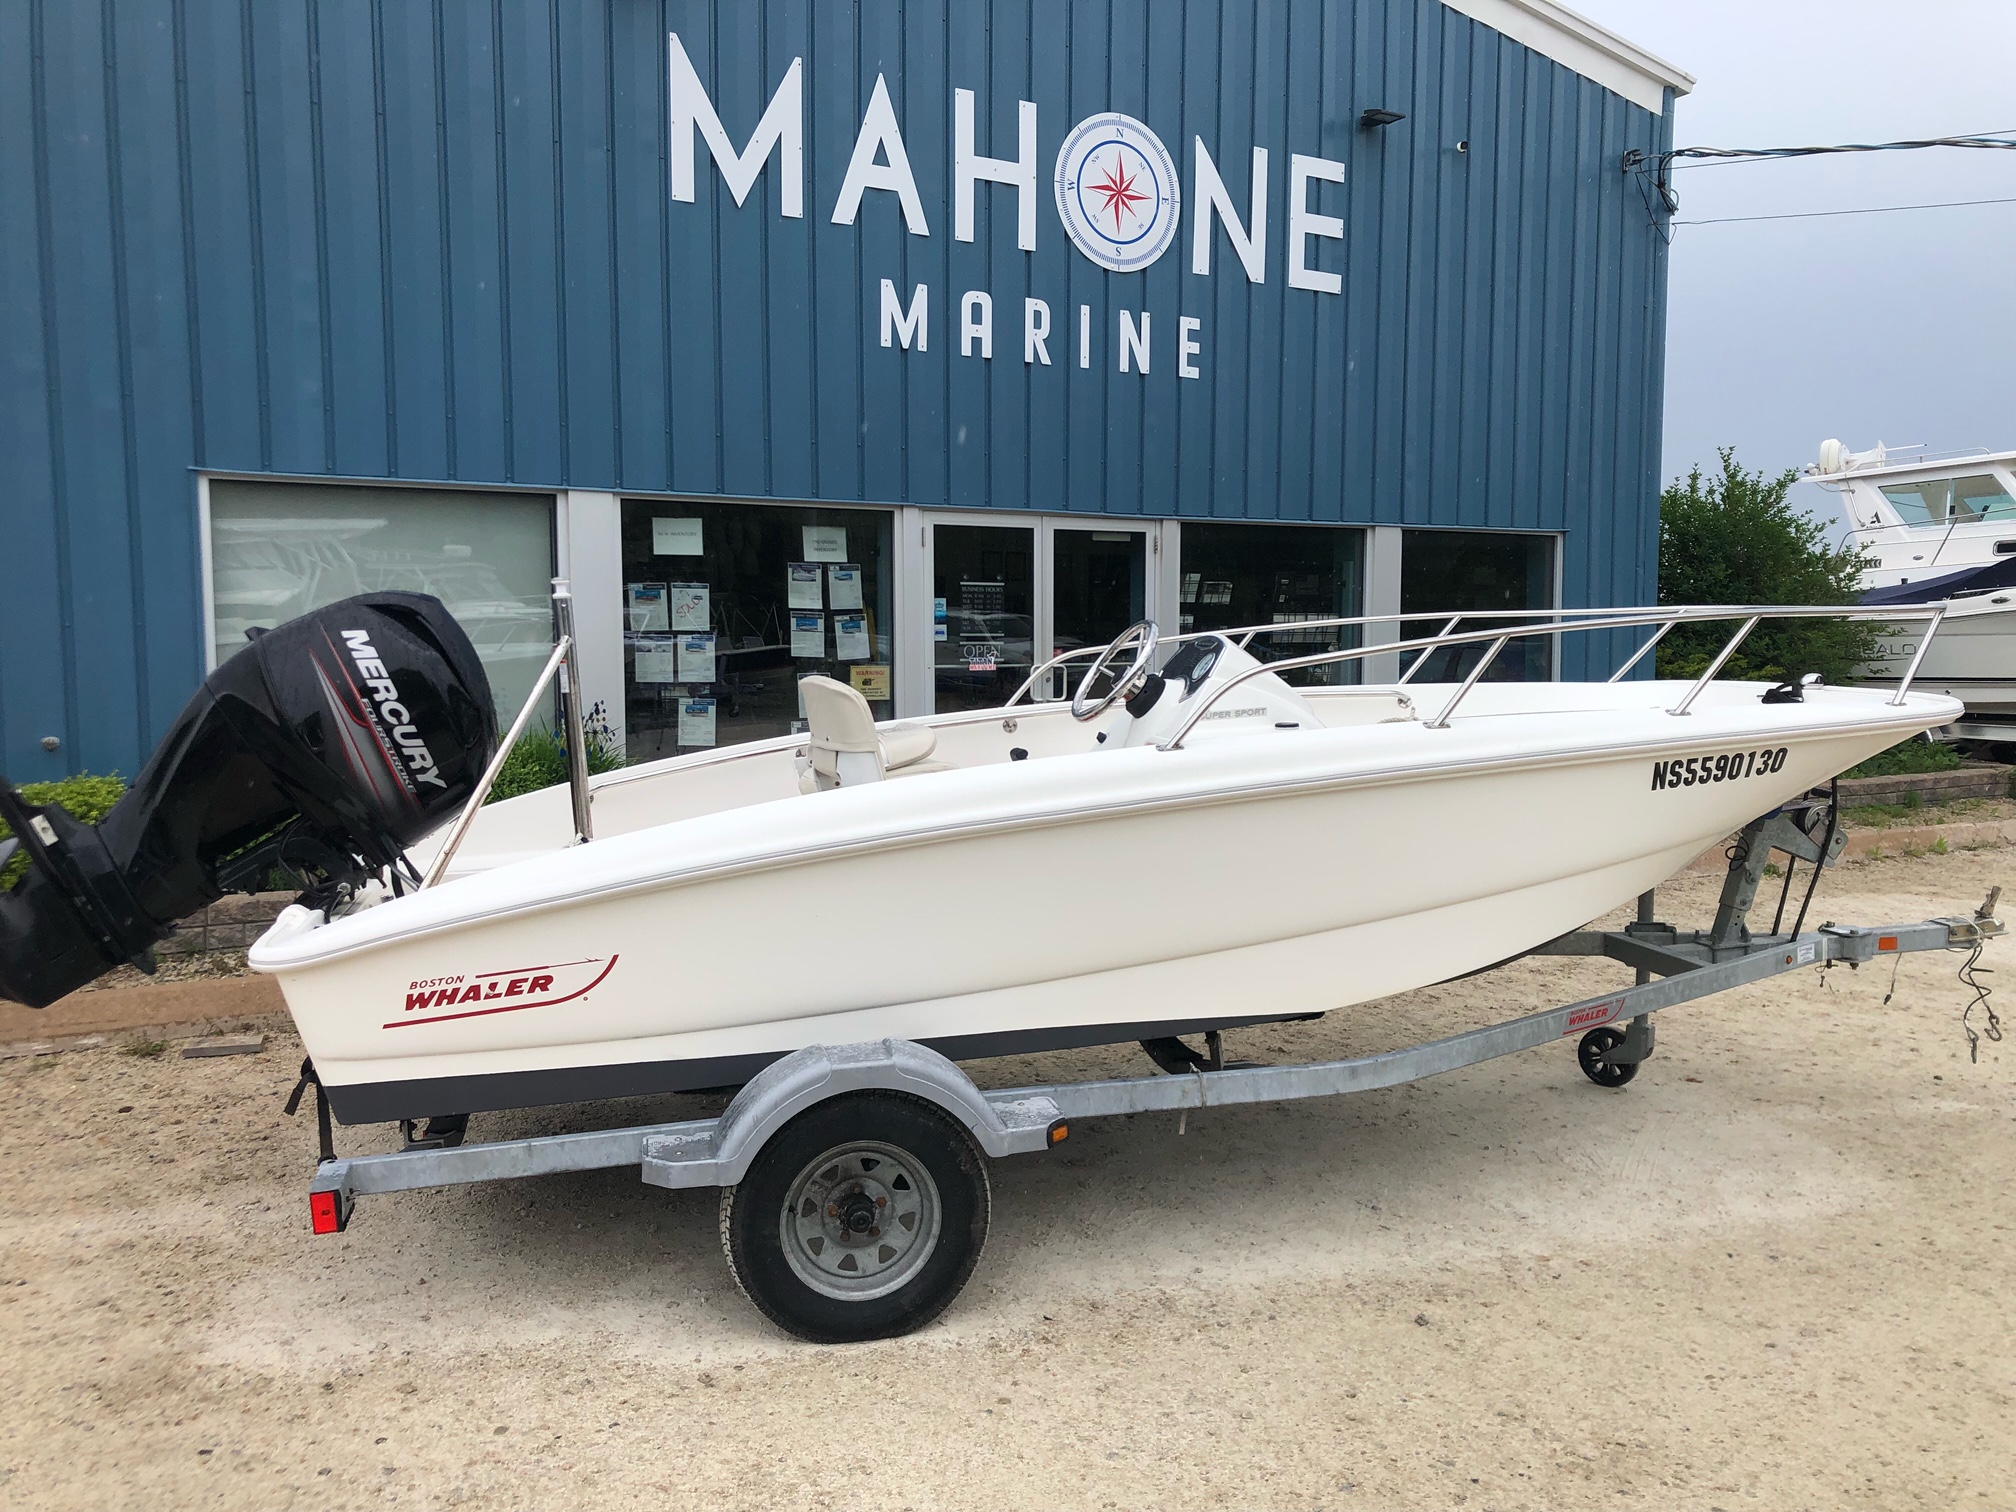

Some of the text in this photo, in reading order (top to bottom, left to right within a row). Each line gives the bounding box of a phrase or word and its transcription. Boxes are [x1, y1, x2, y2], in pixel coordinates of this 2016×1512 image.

[1116, 128, 1125, 139] N
[670, 32, 1345, 294] MAHONE
[1161, 197, 1170, 205] E
[1115, 247, 1122, 257] S
[880, 279, 1200, 379] MARINE
[963, 644, 1001, 658] OPEN
[341, 630, 448, 788] MERCURY
[1234, 707, 1267, 717] SPORT
[361, 698, 417, 793] FOURSTROKE
[1651, 747, 1788, 791] NS5590130
[409, 975, 465, 990] BOSTON
[405, 975, 554, 1011] WHALER
[1569, 1007, 1609, 1026] WHALER
